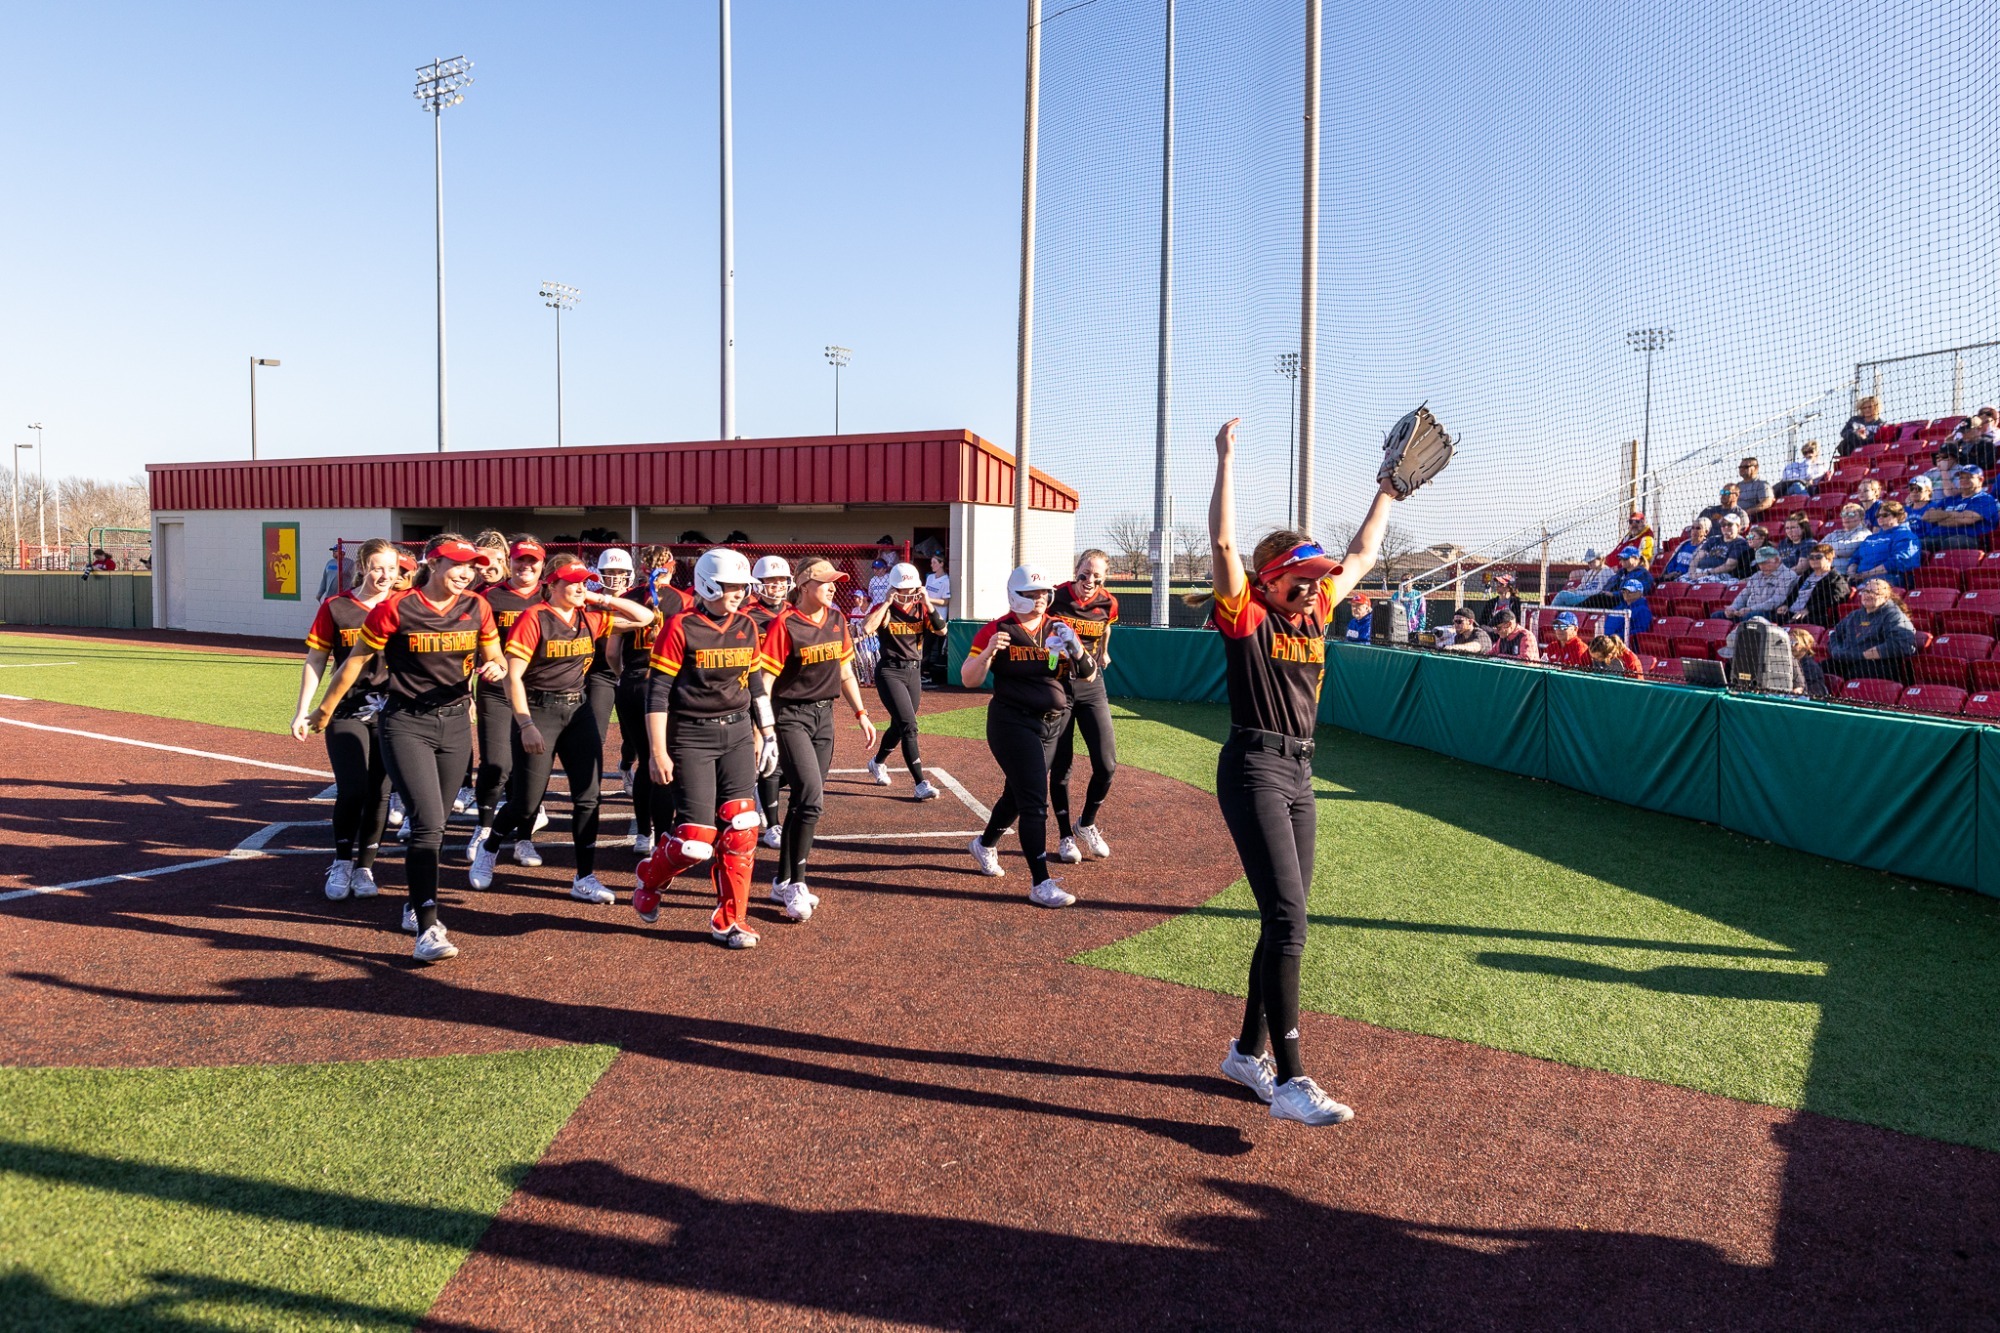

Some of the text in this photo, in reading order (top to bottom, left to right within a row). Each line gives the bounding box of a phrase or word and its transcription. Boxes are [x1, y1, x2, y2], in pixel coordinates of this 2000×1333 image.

[498, 611, 523, 627] PIT
[340, 628, 362, 648] PIT
[408, 630, 478, 653] PITT STATE
[1270, 632, 1309, 663] PITT
[546, 640, 573, 658] PITT
[695, 649, 724, 669] PITT
[800, 644, 825, 666] PITT
[1009, 645, 1035, 661] PITT
